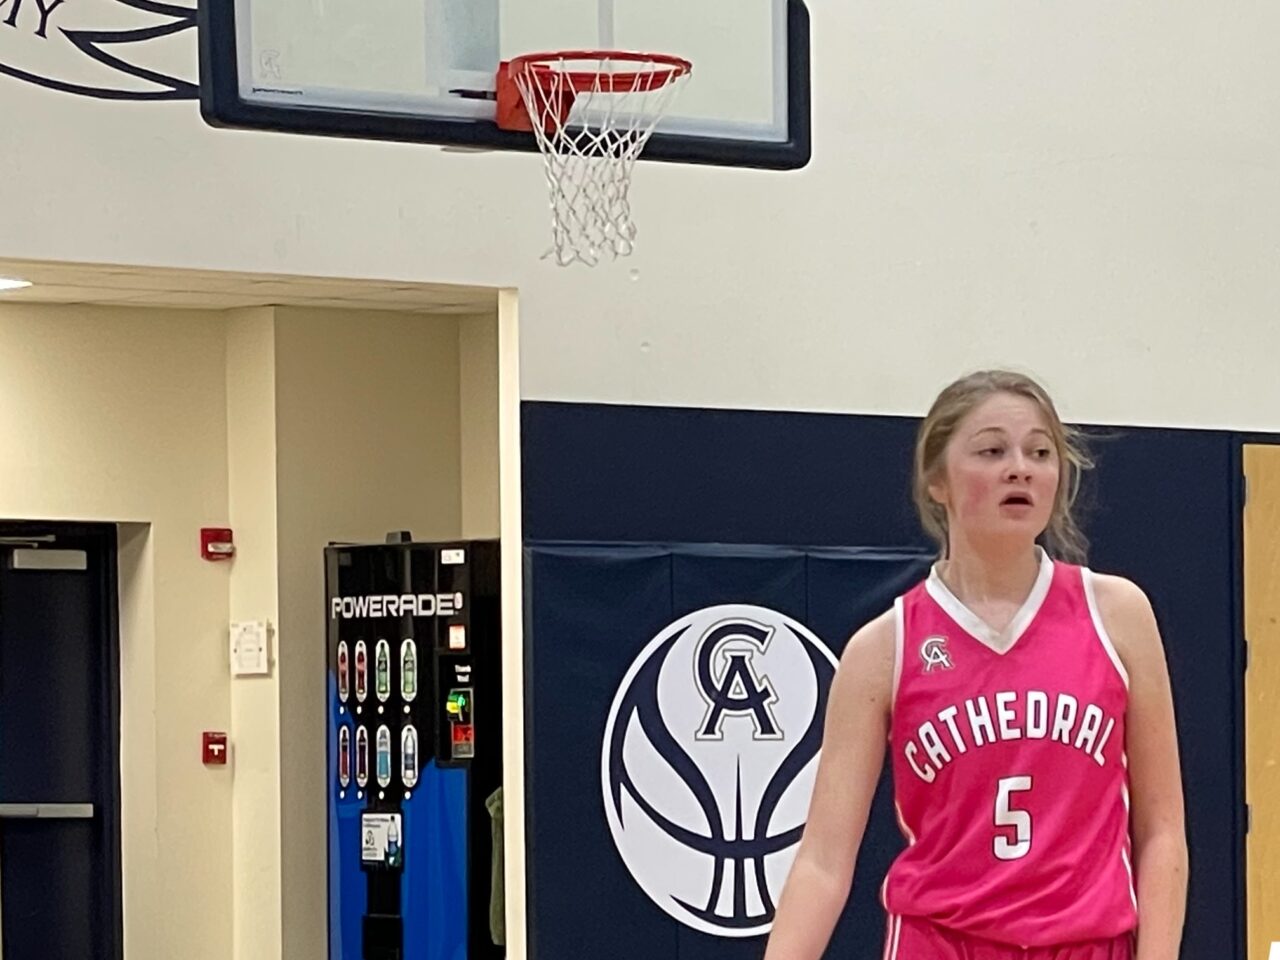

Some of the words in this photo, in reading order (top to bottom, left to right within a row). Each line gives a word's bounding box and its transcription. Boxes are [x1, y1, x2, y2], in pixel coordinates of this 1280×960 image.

[332, 594, 454, 619] POWERADE
[903, 690, 1116, 784] CATHEDRAL
[992, 774, 1034, 861] 5
